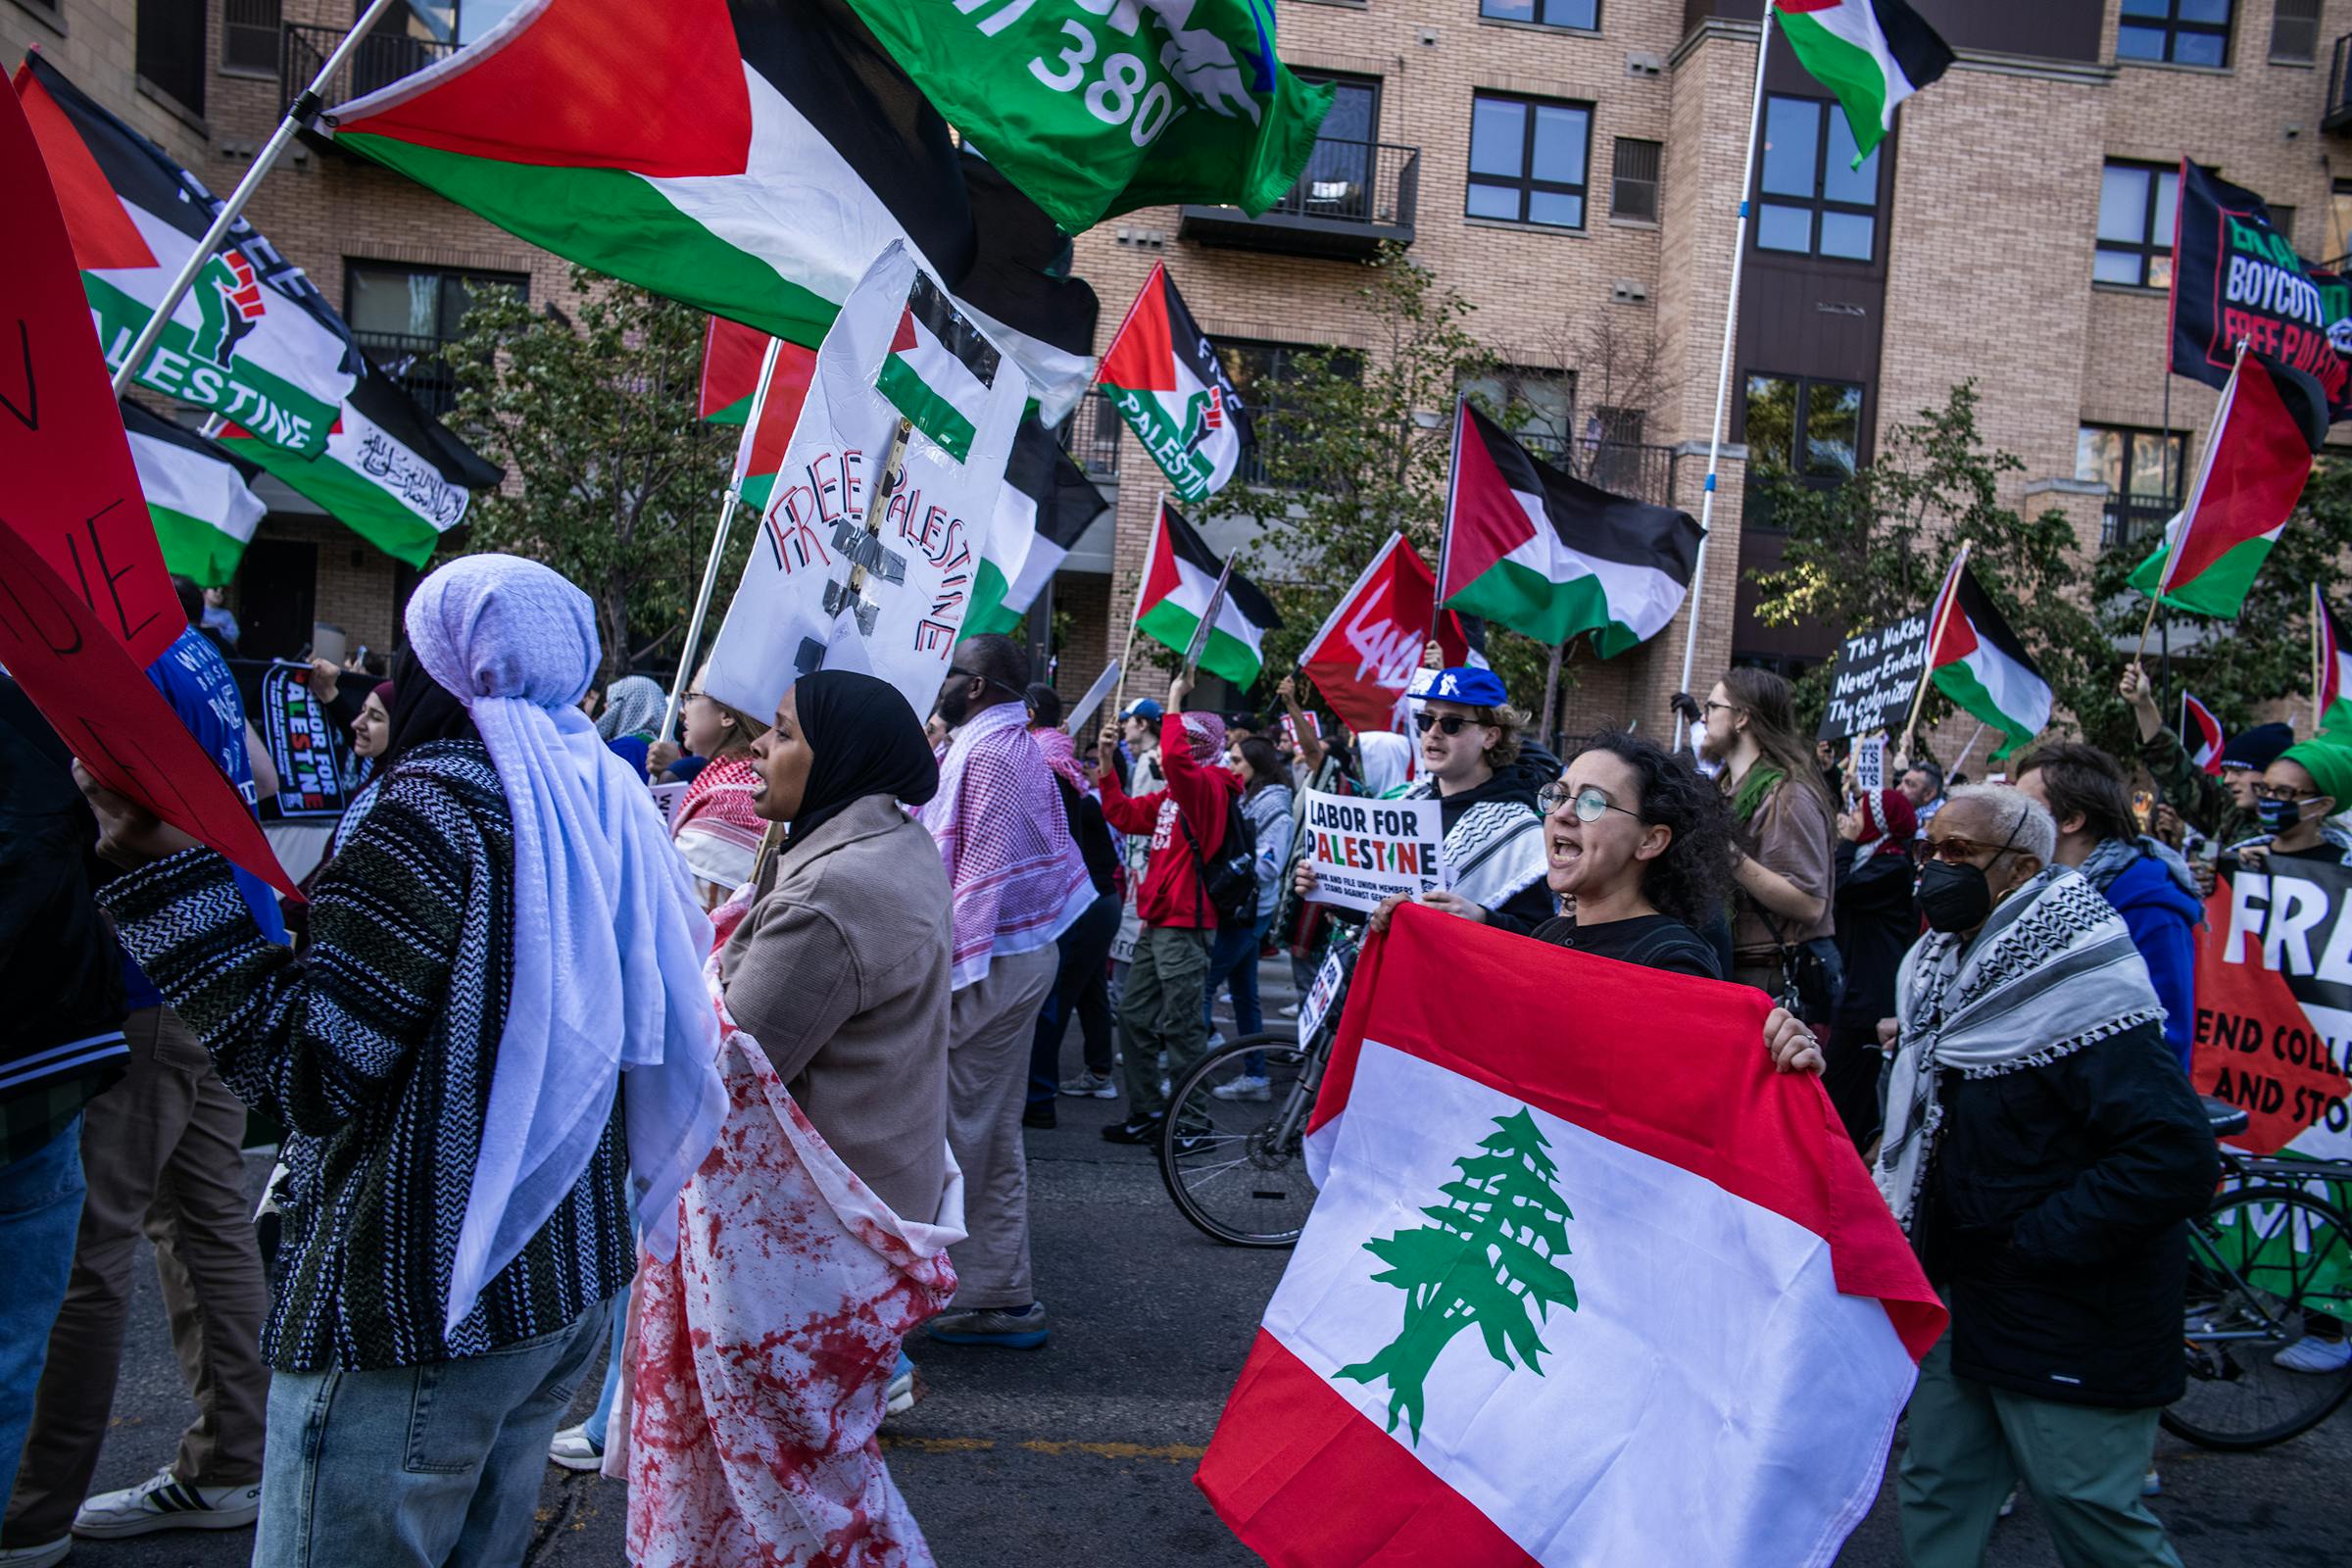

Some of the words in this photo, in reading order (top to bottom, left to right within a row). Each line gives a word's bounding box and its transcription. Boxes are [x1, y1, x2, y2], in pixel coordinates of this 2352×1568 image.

[1027, 19, 1188, 147] 380
[2226, 254, 2324, 328] BOYCOTT
[90, 308, 312, 449] LESTINE
[1117, 392, 1205, 499] PALESTI
[764, 450, 862, 575] FREE
[875, 463, 973, 661] PALESTINE
[1835, 665, 1882, 698] Never
[1881, 640, 1926, 679] Ended
[1846, 636, 1878, 662] The
[307, 689, 327, 750] BOR
[1829, 699, 1855, 723] The
[315, 753, 338, 796] FOR
[1310, 800, 1367, 833] LABOR
[1373, 809, 1418, 837] FOR
[1306, 829, 1438, 875] PALESTINE
[2195, 1008, 2263, 1054] END
[2212, 1066, 2284, 1114] AND
[2292, 1086, 2352, 1138] STO
